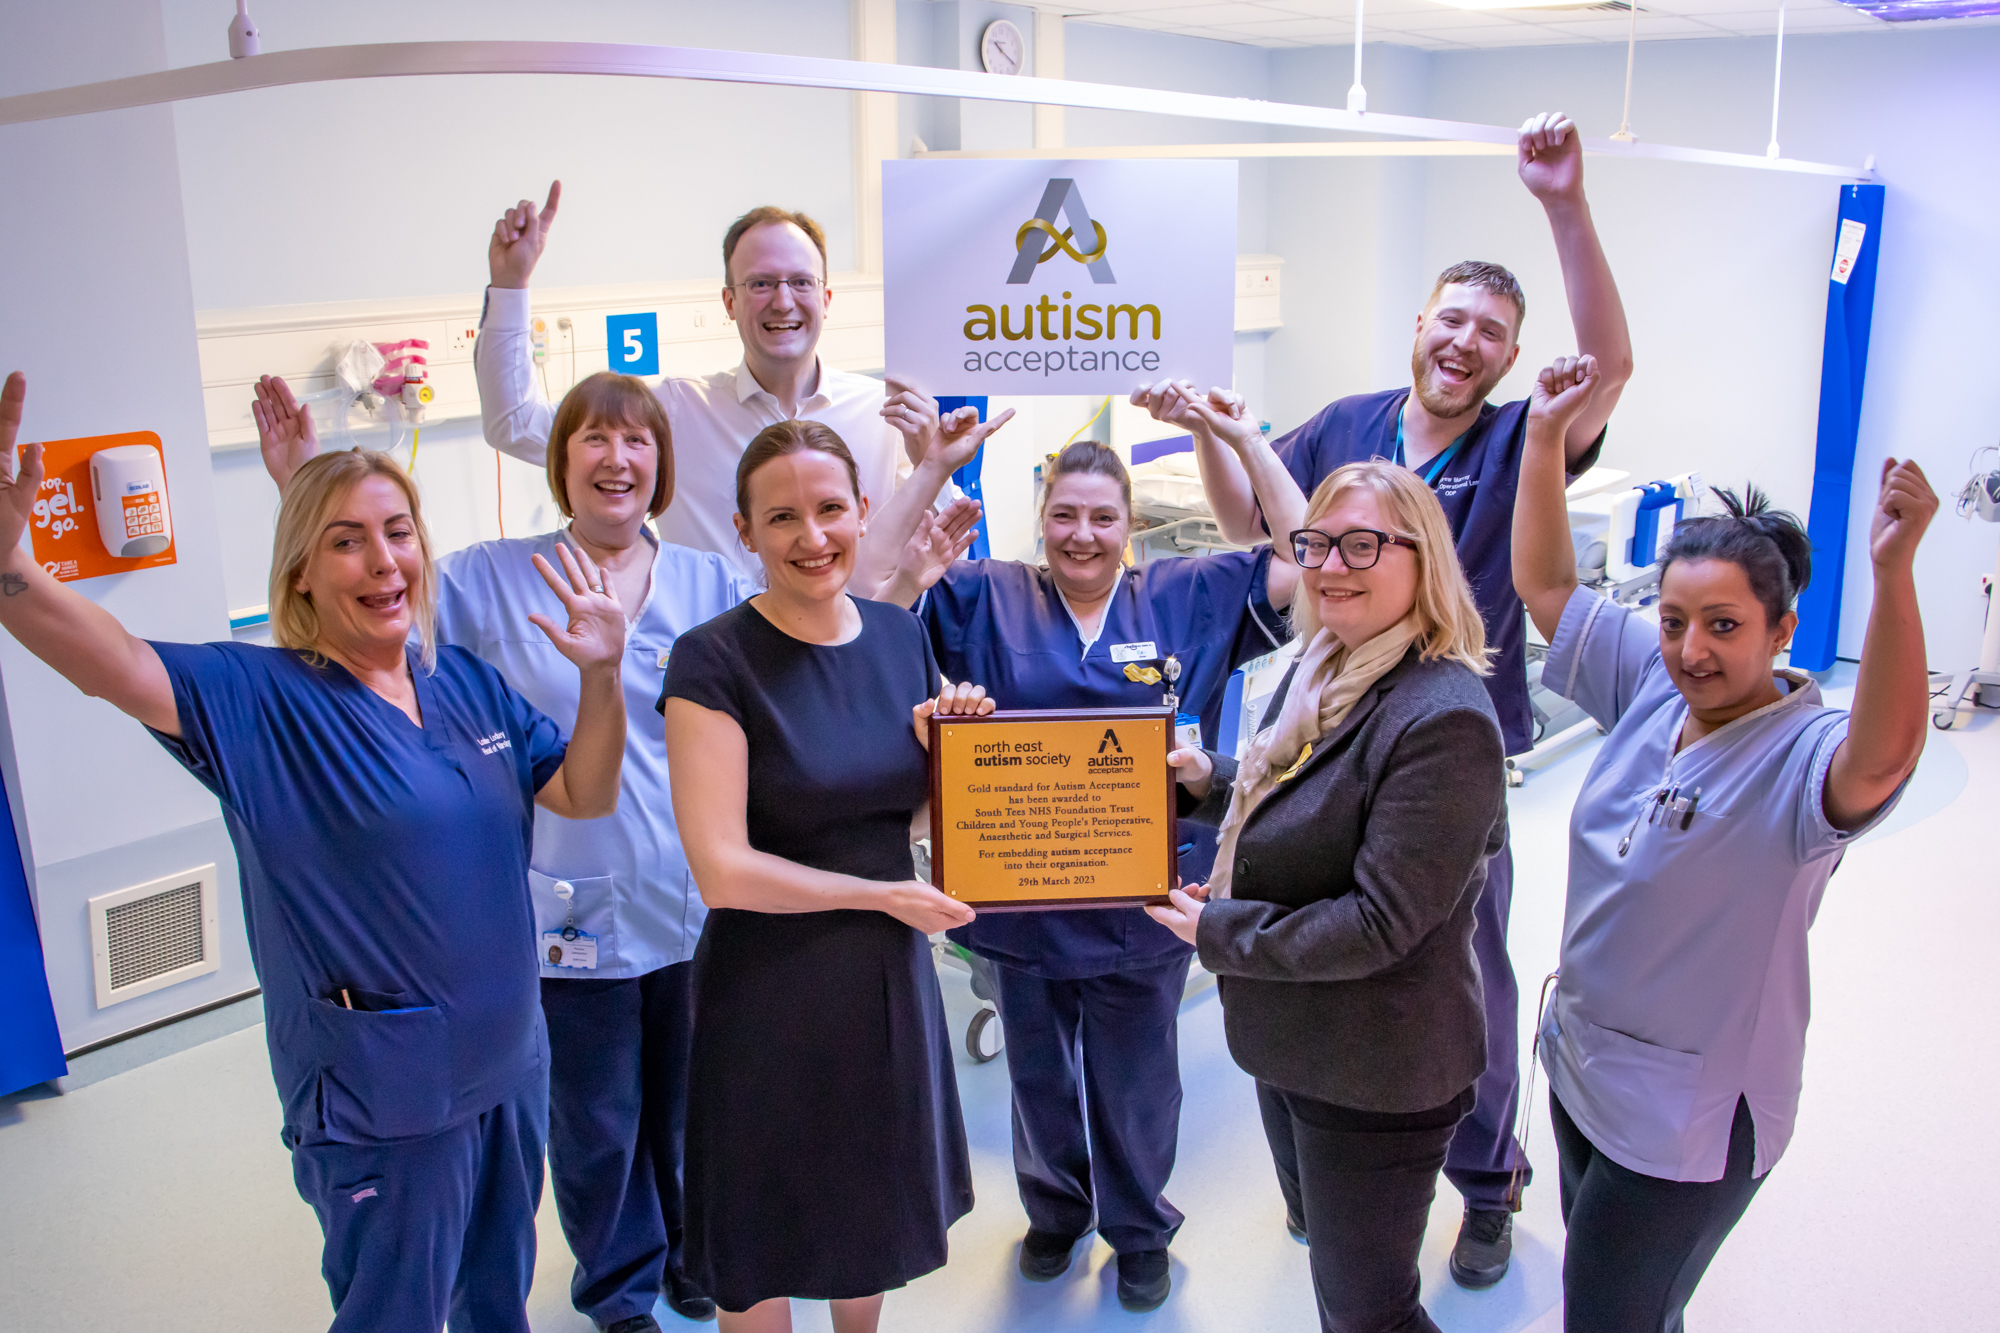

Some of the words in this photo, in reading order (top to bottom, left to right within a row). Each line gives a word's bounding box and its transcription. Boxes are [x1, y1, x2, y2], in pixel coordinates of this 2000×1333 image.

[963, 291, 1161, 341] autism
[623, 328, 643, 363] 5
[963, 345, 1161, 377] acceptance
[33, 482, 84, 528] gel.
[51, 517, 79, 540] go.
[974, 740, 1010, 753] north
[1014, 740, 1043, 752] east
[974, 754, 1022, 766] autism
[1025, 753, 1071, 767] society
[1088, 754, 1133, 766] autism
[968, 785, 991, 793] Gold
[994, 783, 1033, 792] standard
[1036, 783, 1050, 791] for
[1053, 782, 1085, 791] Autism
[1089, 781, 1141, 791] Acceptance
[1009, 795, 1023, 804] has
[1027, 795, 1048, 803] been
[1052, 794, 1089, 803] awarded
[975, 808, 1002, 817] South
[1005, 808, 1025, 816] Tees
[1029, 807, 1052, 815] NHS
[1055, 805, 1106, 815] Foundation
[1109, 805, 1134, 813] Trust
[956, 820, 996, 830] Children
[999, 820, 1016, 828] and
[1019, 820, 1048, 830] Young
[1051, 818, 1089, 829] People's
[1091, 816, 1153, 828] Perioperative,
[978, 832, 1032, 841] Anaesthetic
[1035, 831, 1052, 839] and
[1055, 830, 1090, 841] Surgical
[1093, 829, 1132, 838] Services.
[979, 850, 995, 858] For
[998, 848, 1048, 859] embedding
[1084, 846, 1132, 857] acceptance
[1004, 861, 1023, 870] into
[1026, 860, 1047, 869] their
[1050, 859, 1108, 870] organisation.
[1019, 878, 1039, 886] 29th
[1042, 877, 1070, 886] March
[1073, 876, 1095, 884] 2023
